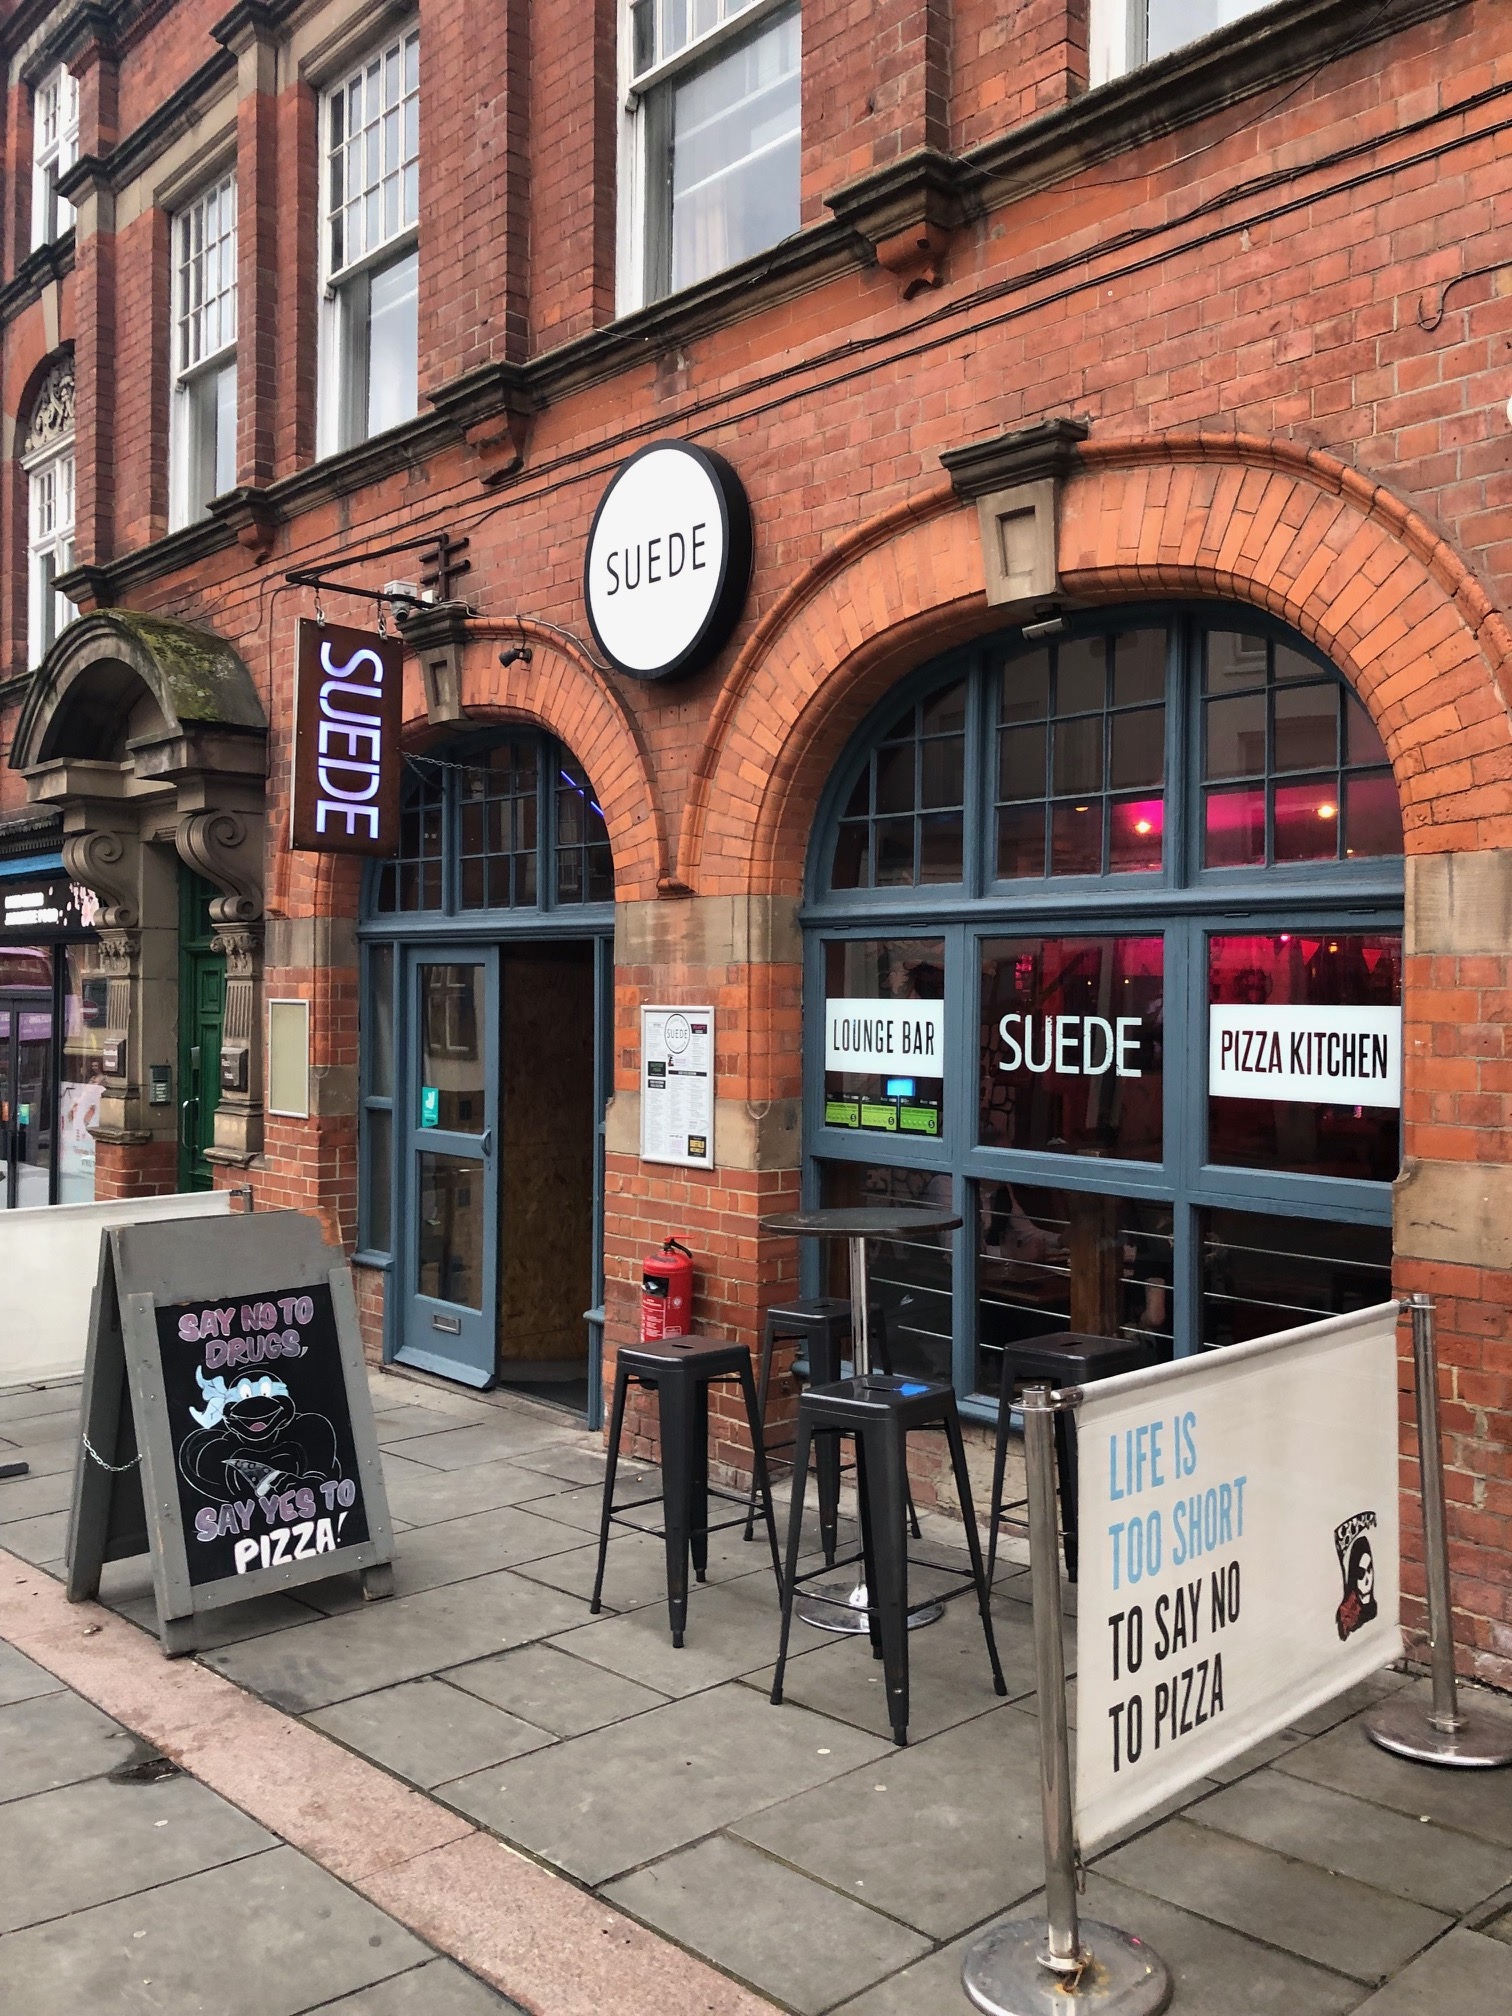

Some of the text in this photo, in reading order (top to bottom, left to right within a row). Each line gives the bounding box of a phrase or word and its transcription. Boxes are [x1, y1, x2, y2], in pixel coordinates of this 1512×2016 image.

[607, 522, 706, 596] SUEDE
[316, 641, 384, 839] SUEDE
[667, 1028, 688, 1039] SUEDE
[832, 1019, 936, 1057] LOUNGE BAR
[998, 1012, 1143, 1078] SUEDE
[1220, 1028, 1389, 1080] PIZZA KITCHEN
[178, 1296, 314, 1342] SAY NO TO
[1109, 1411, 1197, 1501] LIFE IS
[194, 1479, 356, 1542] SAY YES TO
[234, 1511, 348, 1574] PIZZA!
[1108, 1475, 1247, 1591] TOO SHORT
[1108, 1560, 1241, 1681] TO SAY NO
[1108, 1652, 1224, 1773] TO PIZZA
